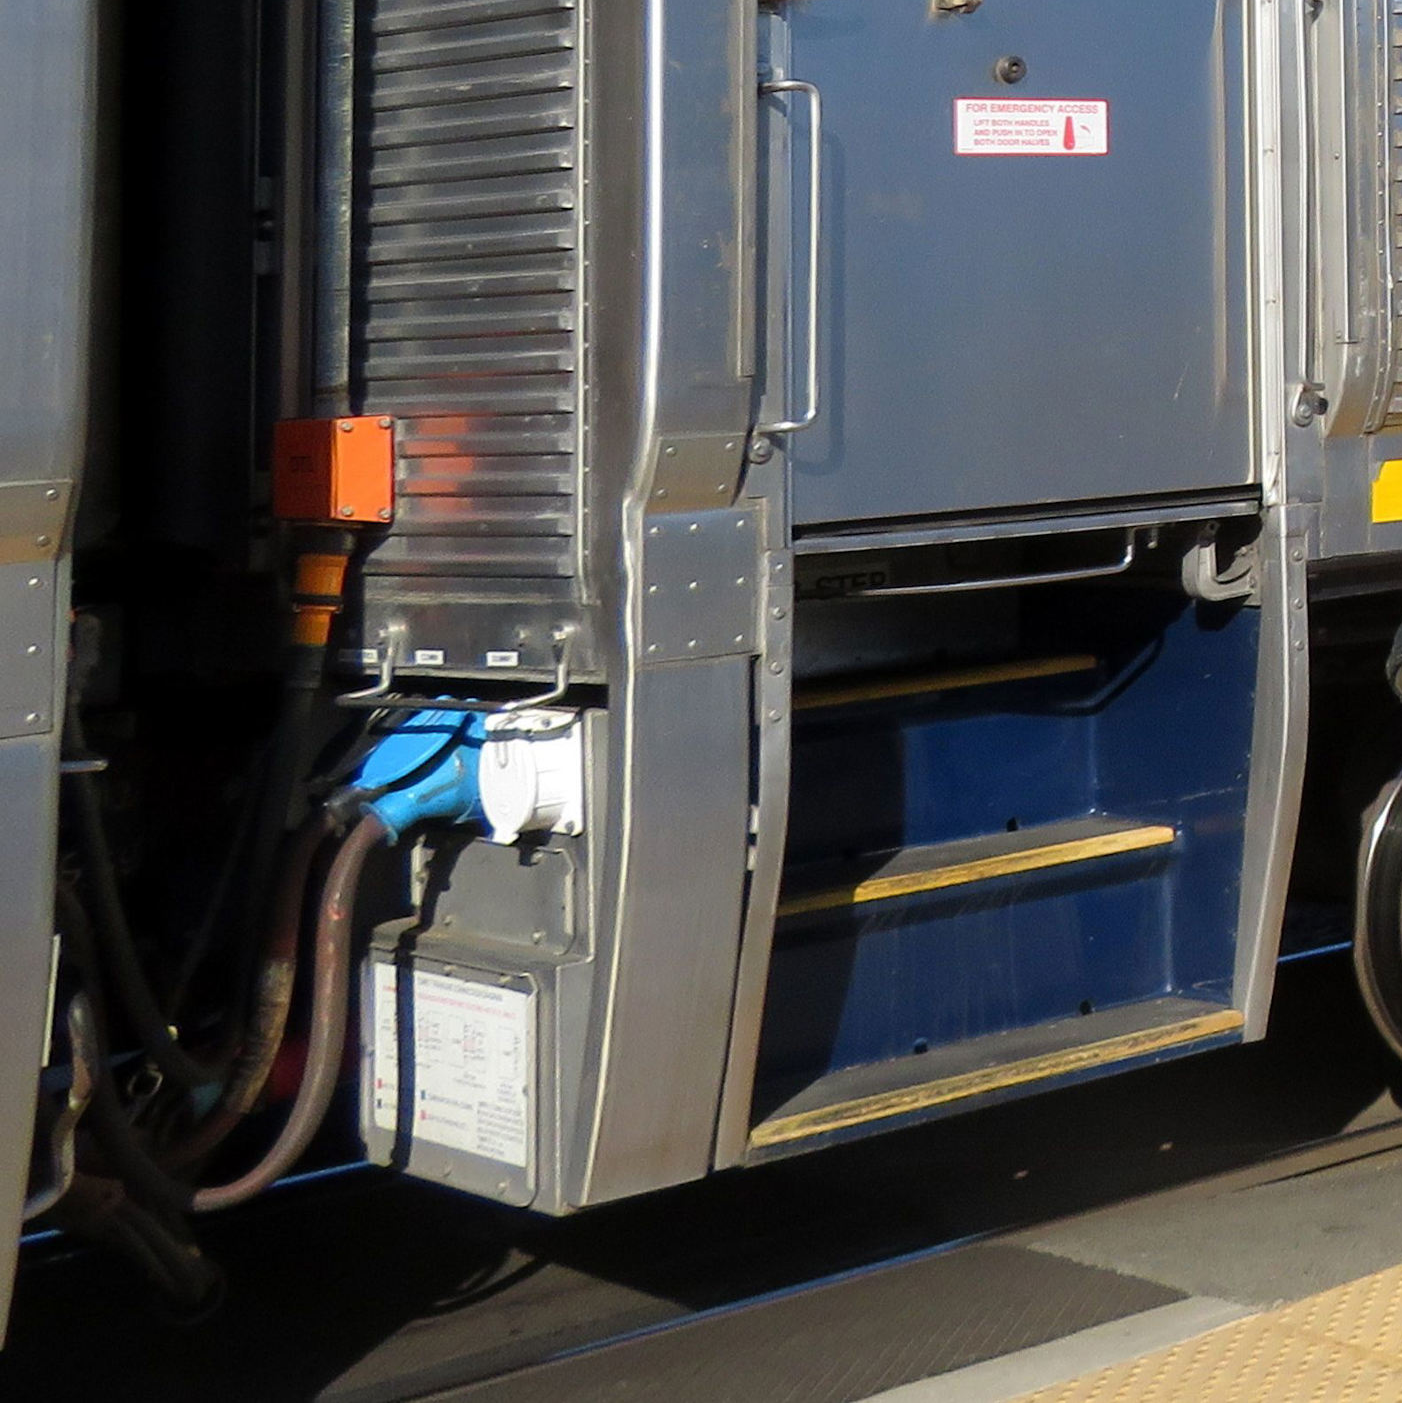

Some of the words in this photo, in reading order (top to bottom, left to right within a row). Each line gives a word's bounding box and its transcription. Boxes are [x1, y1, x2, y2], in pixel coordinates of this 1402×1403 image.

[965, 103, 988, 113] FOR
[990, 104, 1055, 114] EMERGENCY
[1057, 104, 1099, 114] ACCESS
[973, 119, 990, 127] LIFT
[991, 119, 1012, 127] BOTH
[1014, 119, 1050, 127] HANDLES
[1025, 129, 1035, 137] TO
[1036, 129, 1057, 137] OPEN
